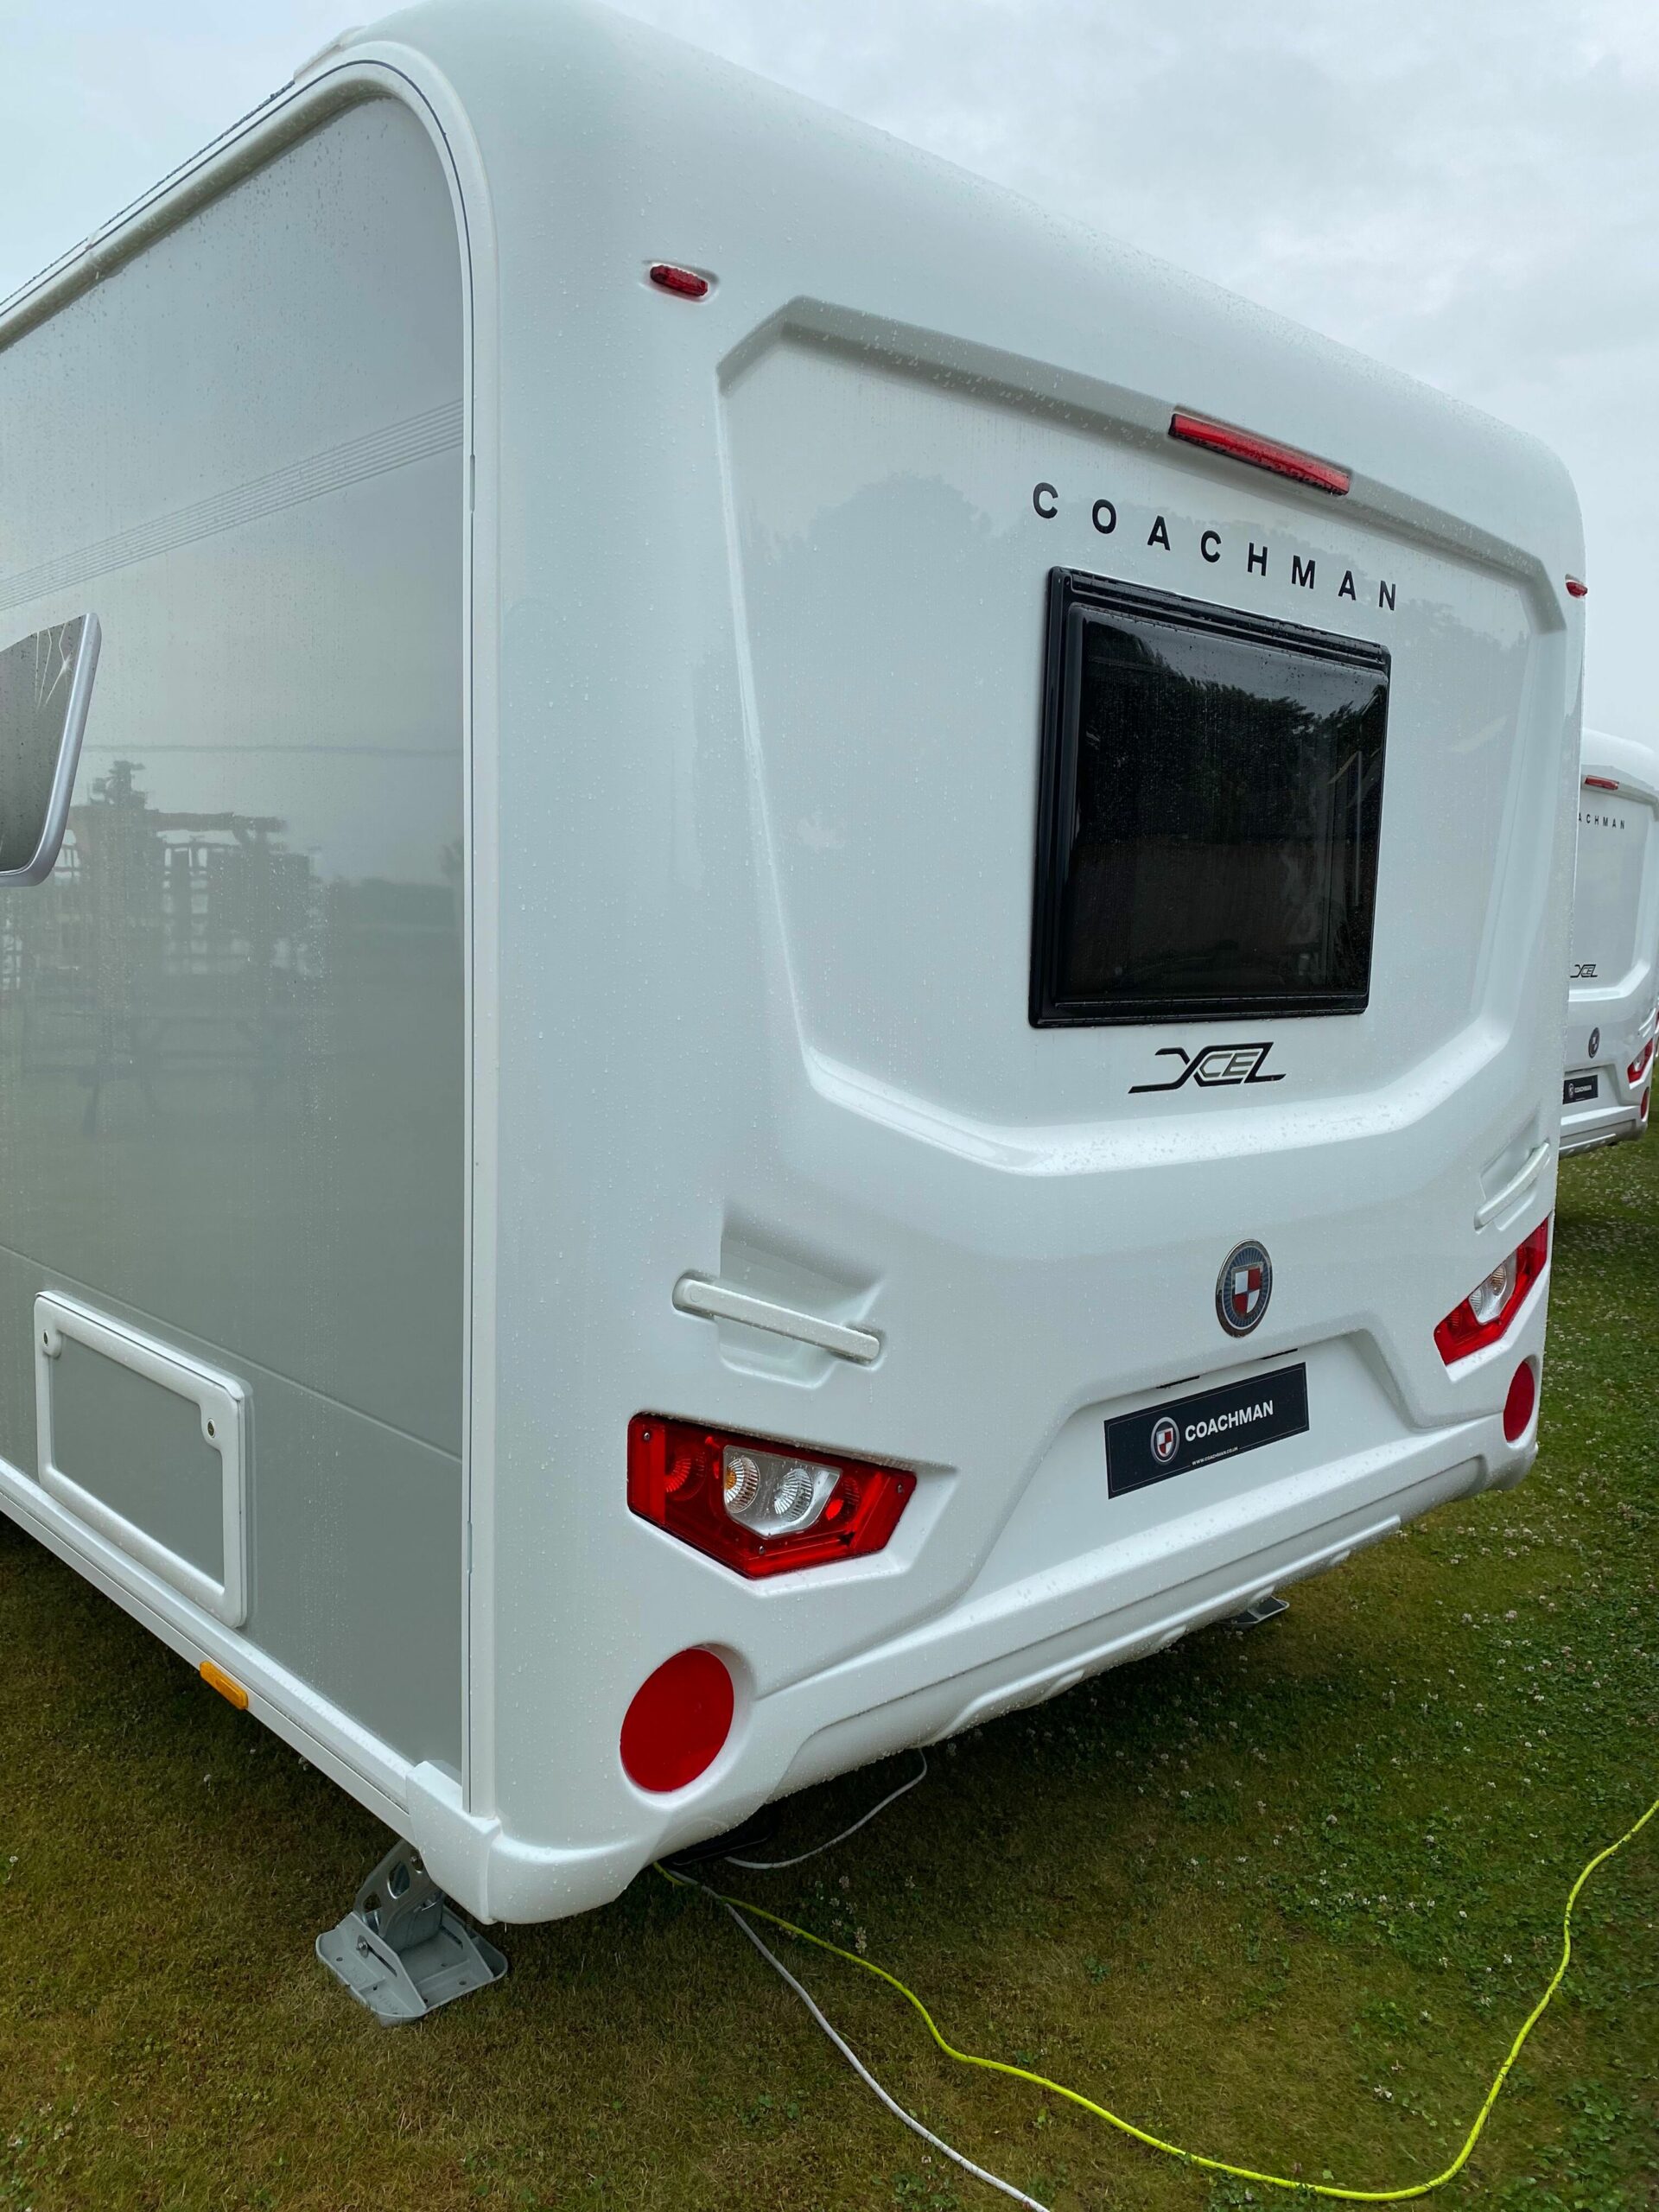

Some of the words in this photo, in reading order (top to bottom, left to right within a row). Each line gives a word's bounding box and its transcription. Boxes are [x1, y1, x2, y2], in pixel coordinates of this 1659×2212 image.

[1033, 481, 1396, 611] COACHMAN
[1128, 1041, 1287, 1094] XCEL
[1185, 1400, 1274, 1442] COACHMAN
